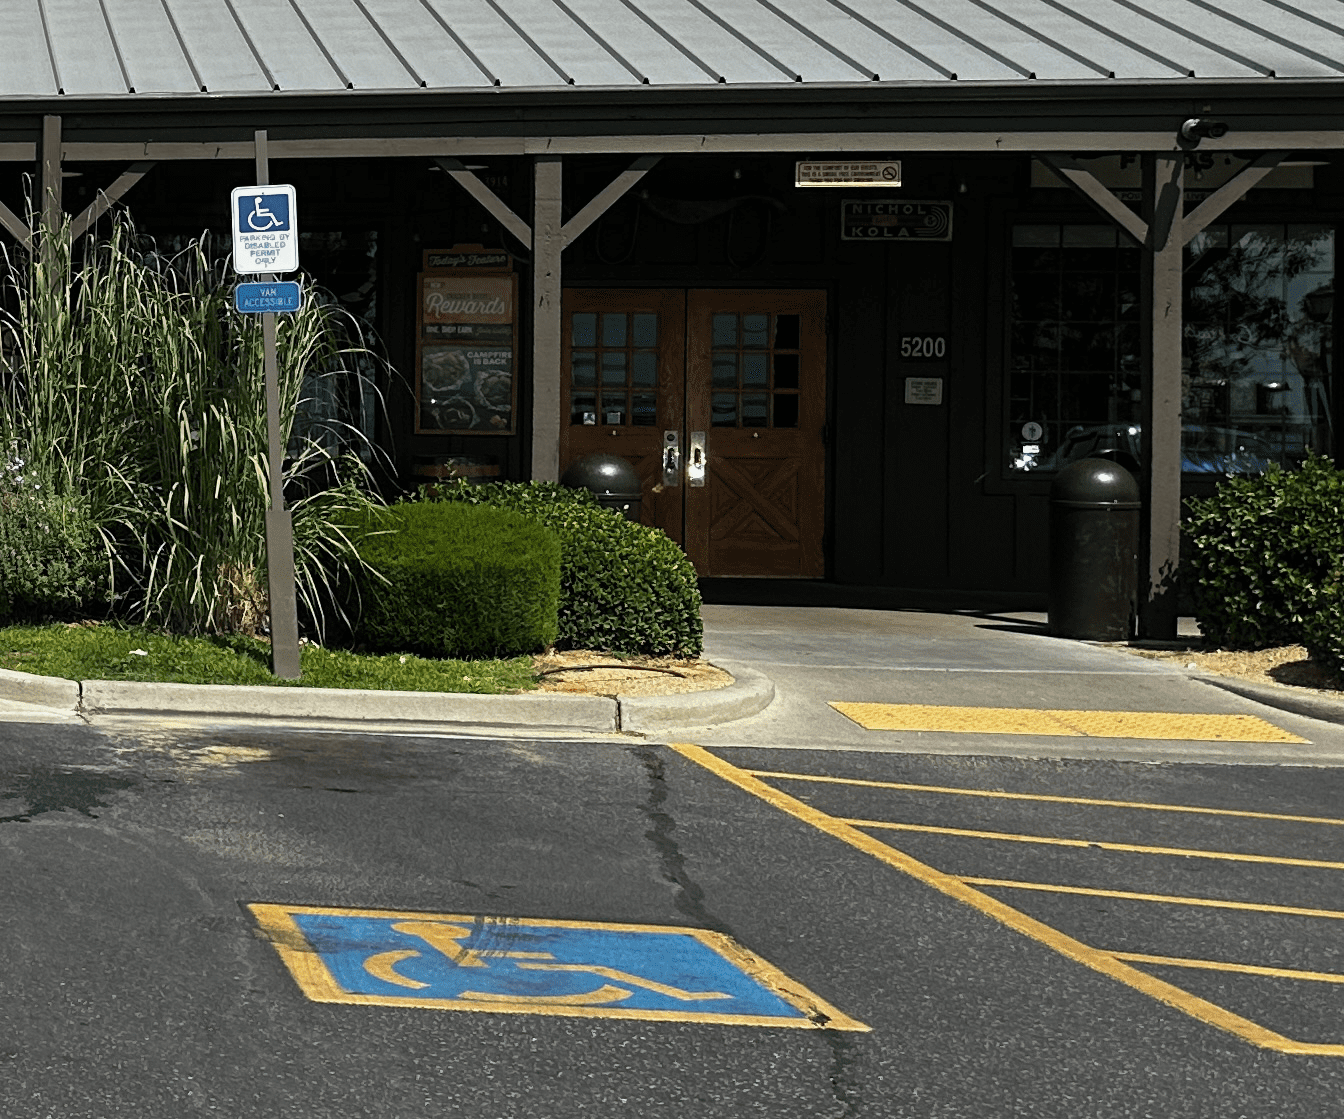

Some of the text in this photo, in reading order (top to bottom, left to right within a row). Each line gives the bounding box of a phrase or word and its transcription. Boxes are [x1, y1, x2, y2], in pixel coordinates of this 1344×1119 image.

[852, 204, 927, 215] NICHOL
[851, 227, 910, 237] KOLA
[429, 254, 506, 267] Today's Feature
[260, 288, 277, 296] VAN
[244, 297, 293, 307] ACCESSIBLE
[426, 292, 505, 319] Rewards
[900, 337, 946, 357] 5200
